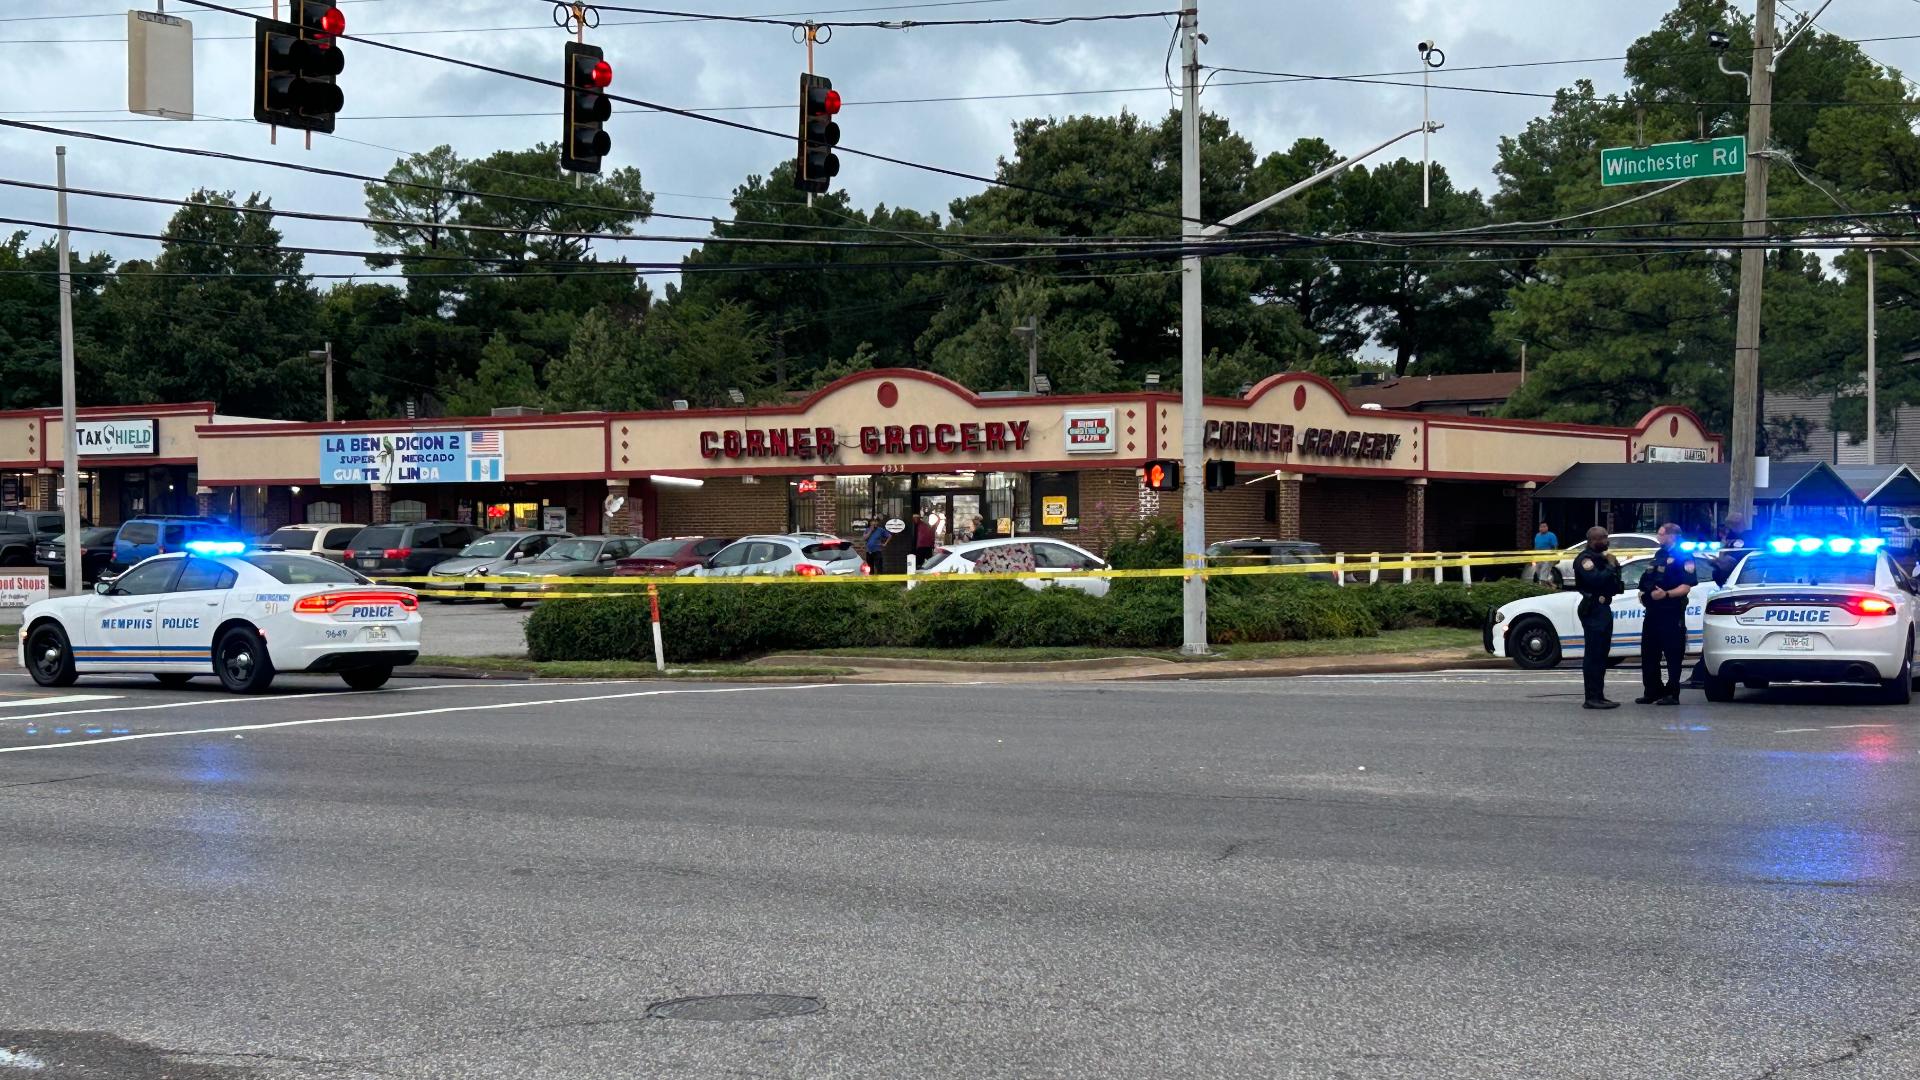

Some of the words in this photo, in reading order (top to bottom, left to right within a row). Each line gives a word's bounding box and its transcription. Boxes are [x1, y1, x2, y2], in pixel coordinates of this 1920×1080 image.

[1607, 153, 1698, 176] Winchester
[1713, 146, 1738, 166] Rd
[326, 438, 345, 452] LA
[449, 436, 460, 449] 2
[700, 427, 836, 459] CORNER
[860, 420, 1031, 455] GROCERY
[1203, 420, 1294, 453] CORNER
[1302, 427, 1400, 460] GROCERY
[340, 455, 376, 464] SUPER
[333, 468, 380, 481] GUATE
[398, 467, 440, 480] LINDA
[17, 577, 45, 591] Shops
[352, 606, 394, 618] POLICE
[1765, 609, 1831, 622] POLICE
[101, 618, 152, 629] MEMPHIS
[162, 617, 200, 629] POLICE
[1725, 635, 1750, 644] 9836
